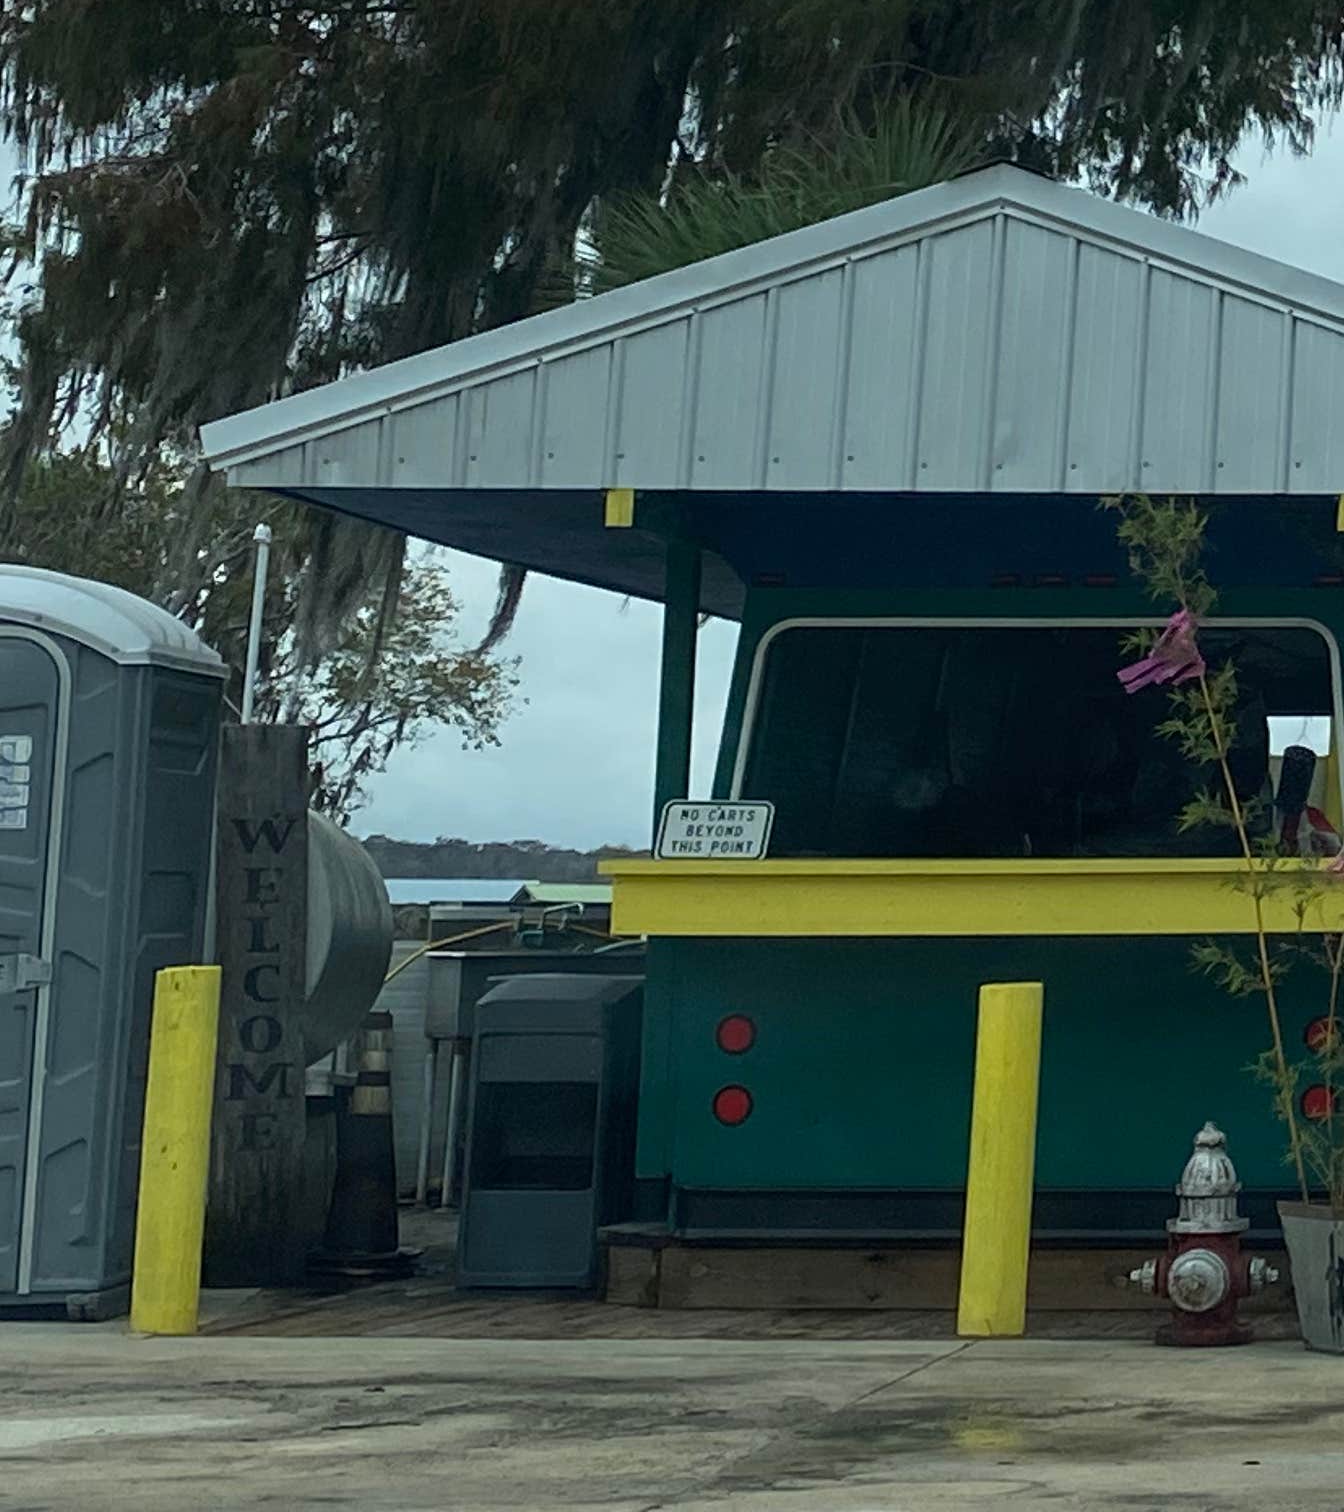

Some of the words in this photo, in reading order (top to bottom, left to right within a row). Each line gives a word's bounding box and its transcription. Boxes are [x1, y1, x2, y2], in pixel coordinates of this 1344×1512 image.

[680, 809, 699, 822] NO
[707, 809, 756, 822] CARTS
[686, 824, 744, 838] BEYOND
[671, 840, 702, 853] THIS
[710, 840, 754, 853] POINT
[224, 818, 297, 1152] WELCOME
